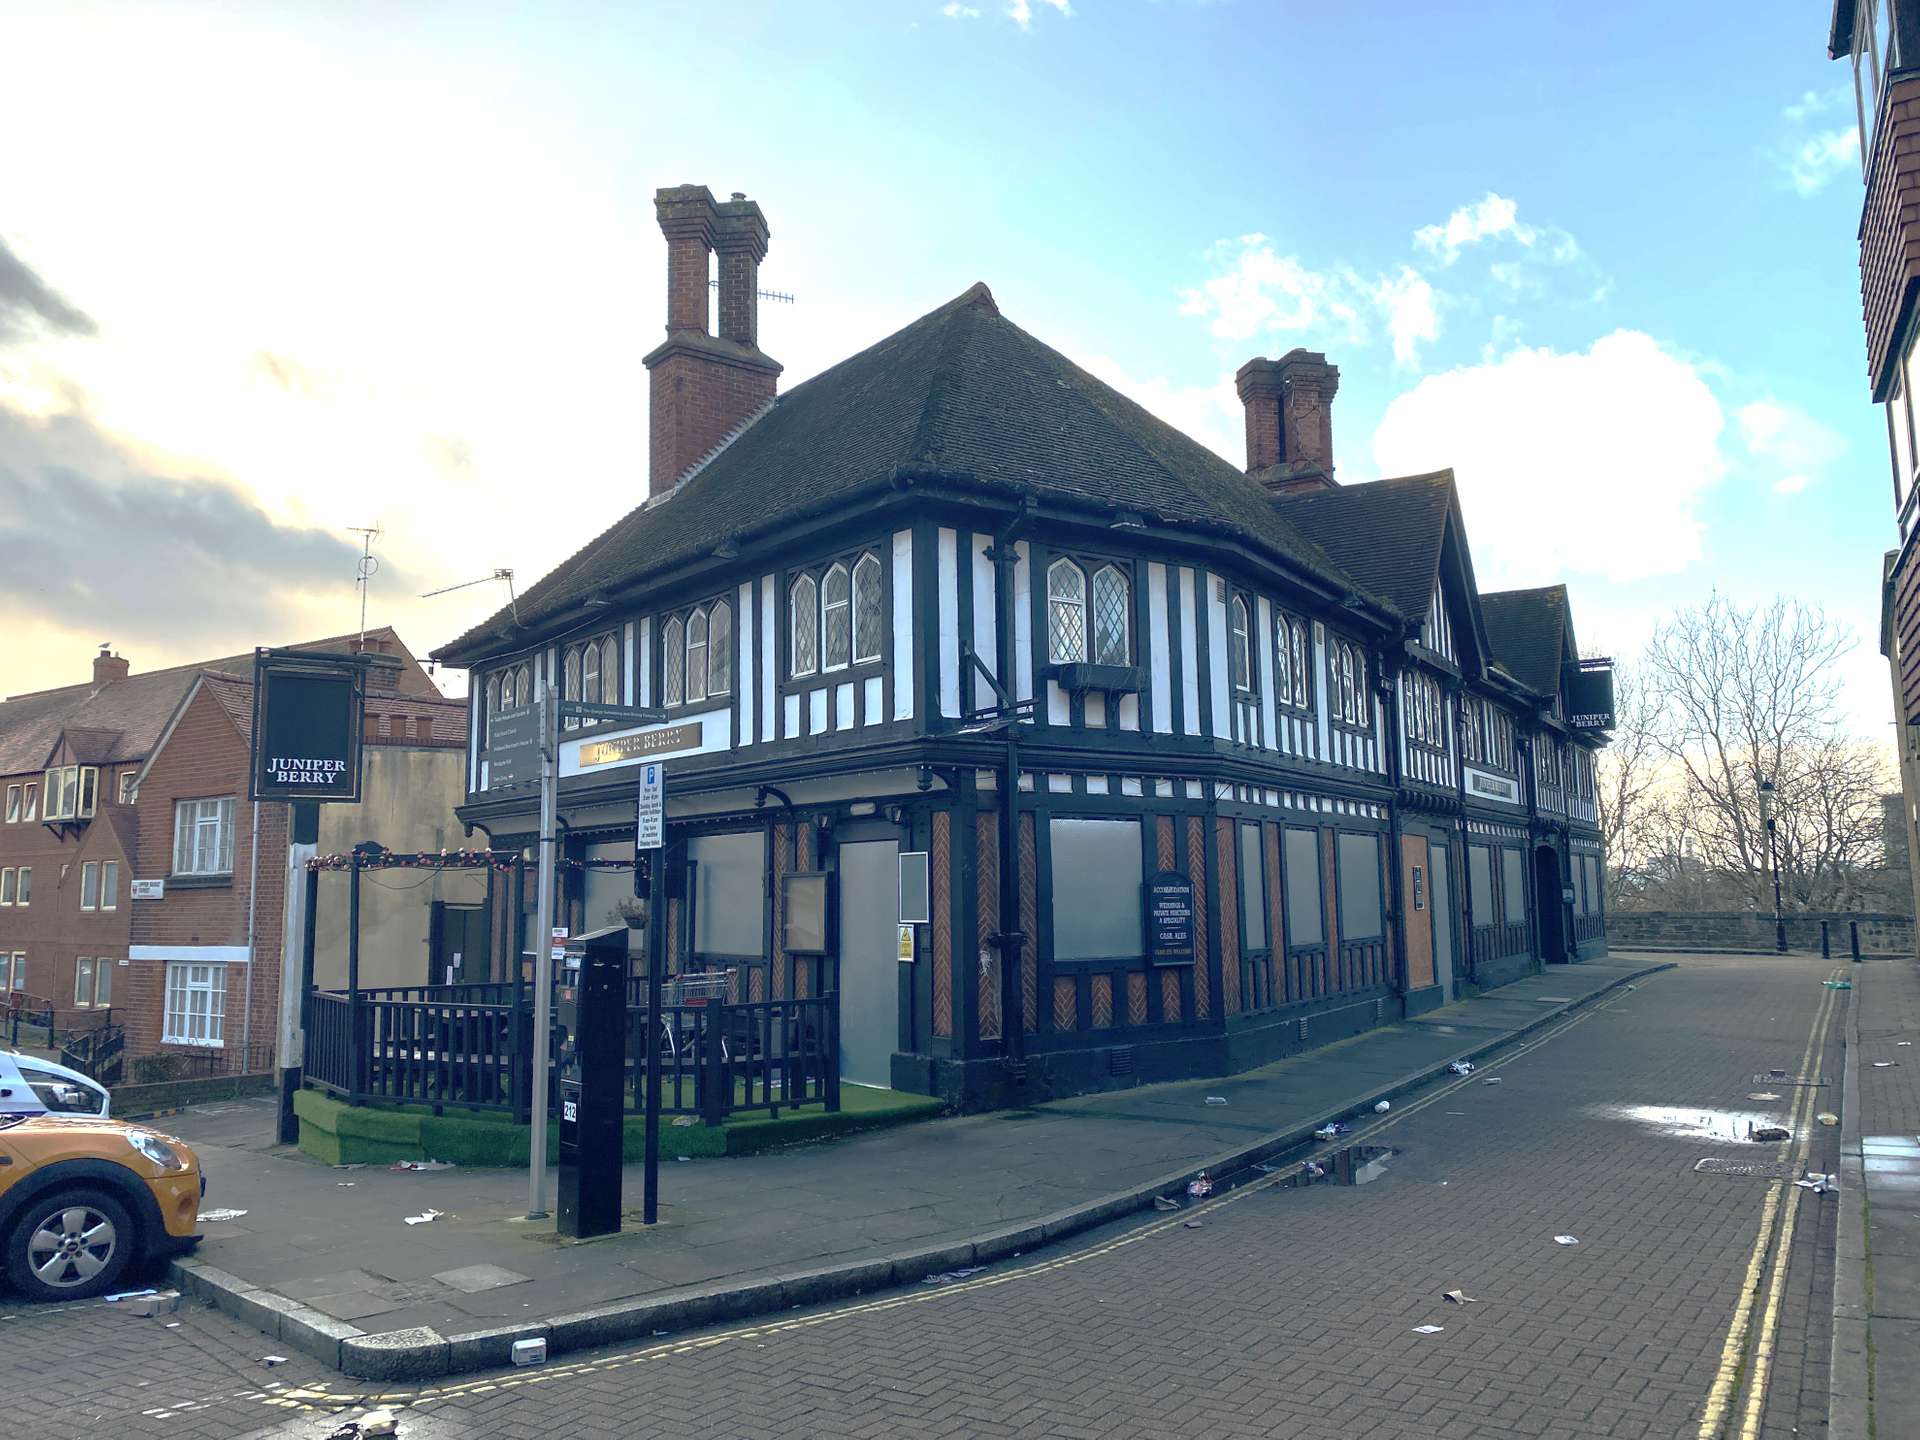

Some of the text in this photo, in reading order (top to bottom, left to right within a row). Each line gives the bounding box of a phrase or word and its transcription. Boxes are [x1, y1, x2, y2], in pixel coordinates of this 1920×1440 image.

[1570, 713, 1610, 724] JUNIPER
[644, 728, 683, 749] BERRY
[267, 757, 346, 773] JUNIPER
[276, 771, 337, 784] BERRY
[565, 1104, 576, 1118] 212
